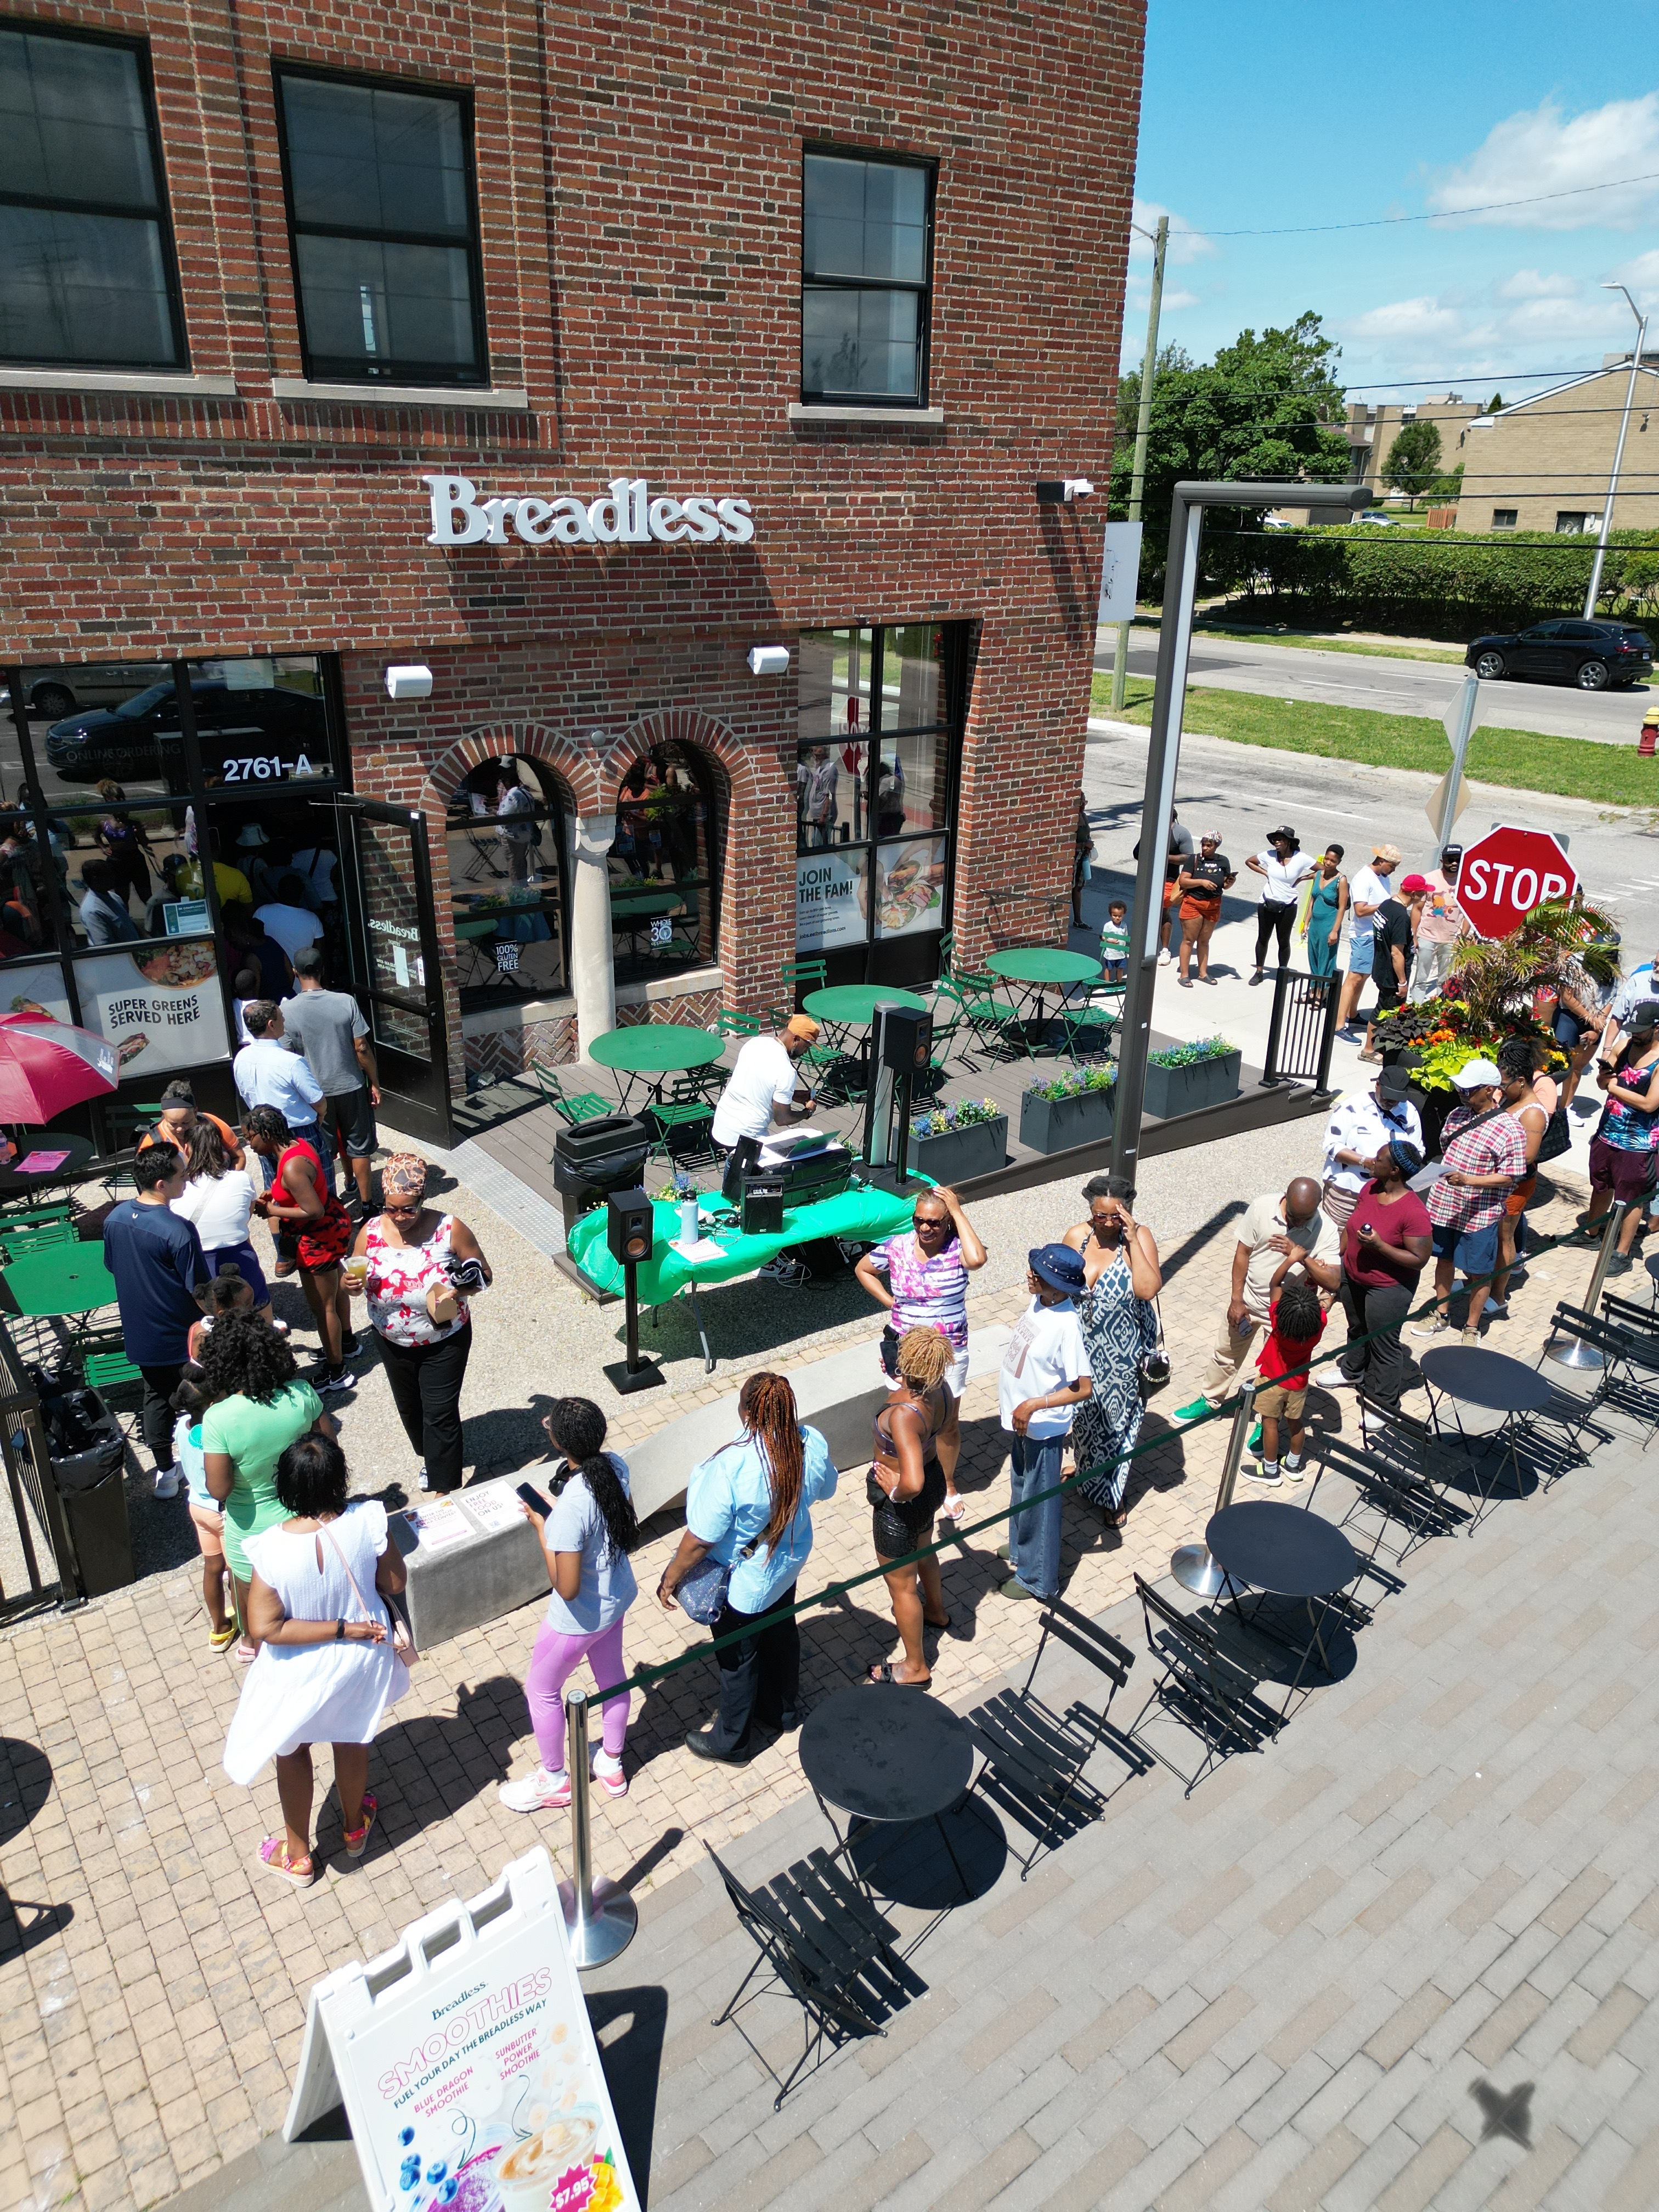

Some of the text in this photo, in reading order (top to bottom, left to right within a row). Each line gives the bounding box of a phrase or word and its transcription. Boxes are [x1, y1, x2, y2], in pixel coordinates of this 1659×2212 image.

[422, 475, 754, 544] Breadless
[223, 754, 313, 781] 2761-A
[799, 867, 832, 886] JOIN
[1464, 859, 1567, 911] STOP
[799, 881, 853, 904] THE FAM!
[651, 918, 672, 927] WHOLE
[651, 926, 672, 942] 30
[496, 944, 518, 955] 100%
[497, 952, 518, 961] GLUTEN
[498, 959, 519, 972] FREE
[108, 995, 198, 1015] SUPER GREENS
[111, 1006, 200, 1029] SERVED HERE
[465, 1491, 489, 1504] ENJOY
[469, 1498, 487, 1508] FREE
[473, 1500, 496, 1512] FOOD
[435, 1511, 456, 1521] CONTEST
[431, 1981, 487, 2021] Breadless
[378, 1967, 552, 2100] SMOOTHIES
[495, 2028, 538, 2059] SUNBUTTER
[393, 1998, 547, 2109] FUEL YOUR DAY THE BREADLESS WAY
[500, 2049, 540, 2080] SMOOTHIE
[504, 2042, 533, 2066] POWER
[414, 2066, 474, 2113] BLUE DRAGON
[425, 2081, 470, 2118] SMOOTHIE
[555, 2175, 589, 2209] $7.95
